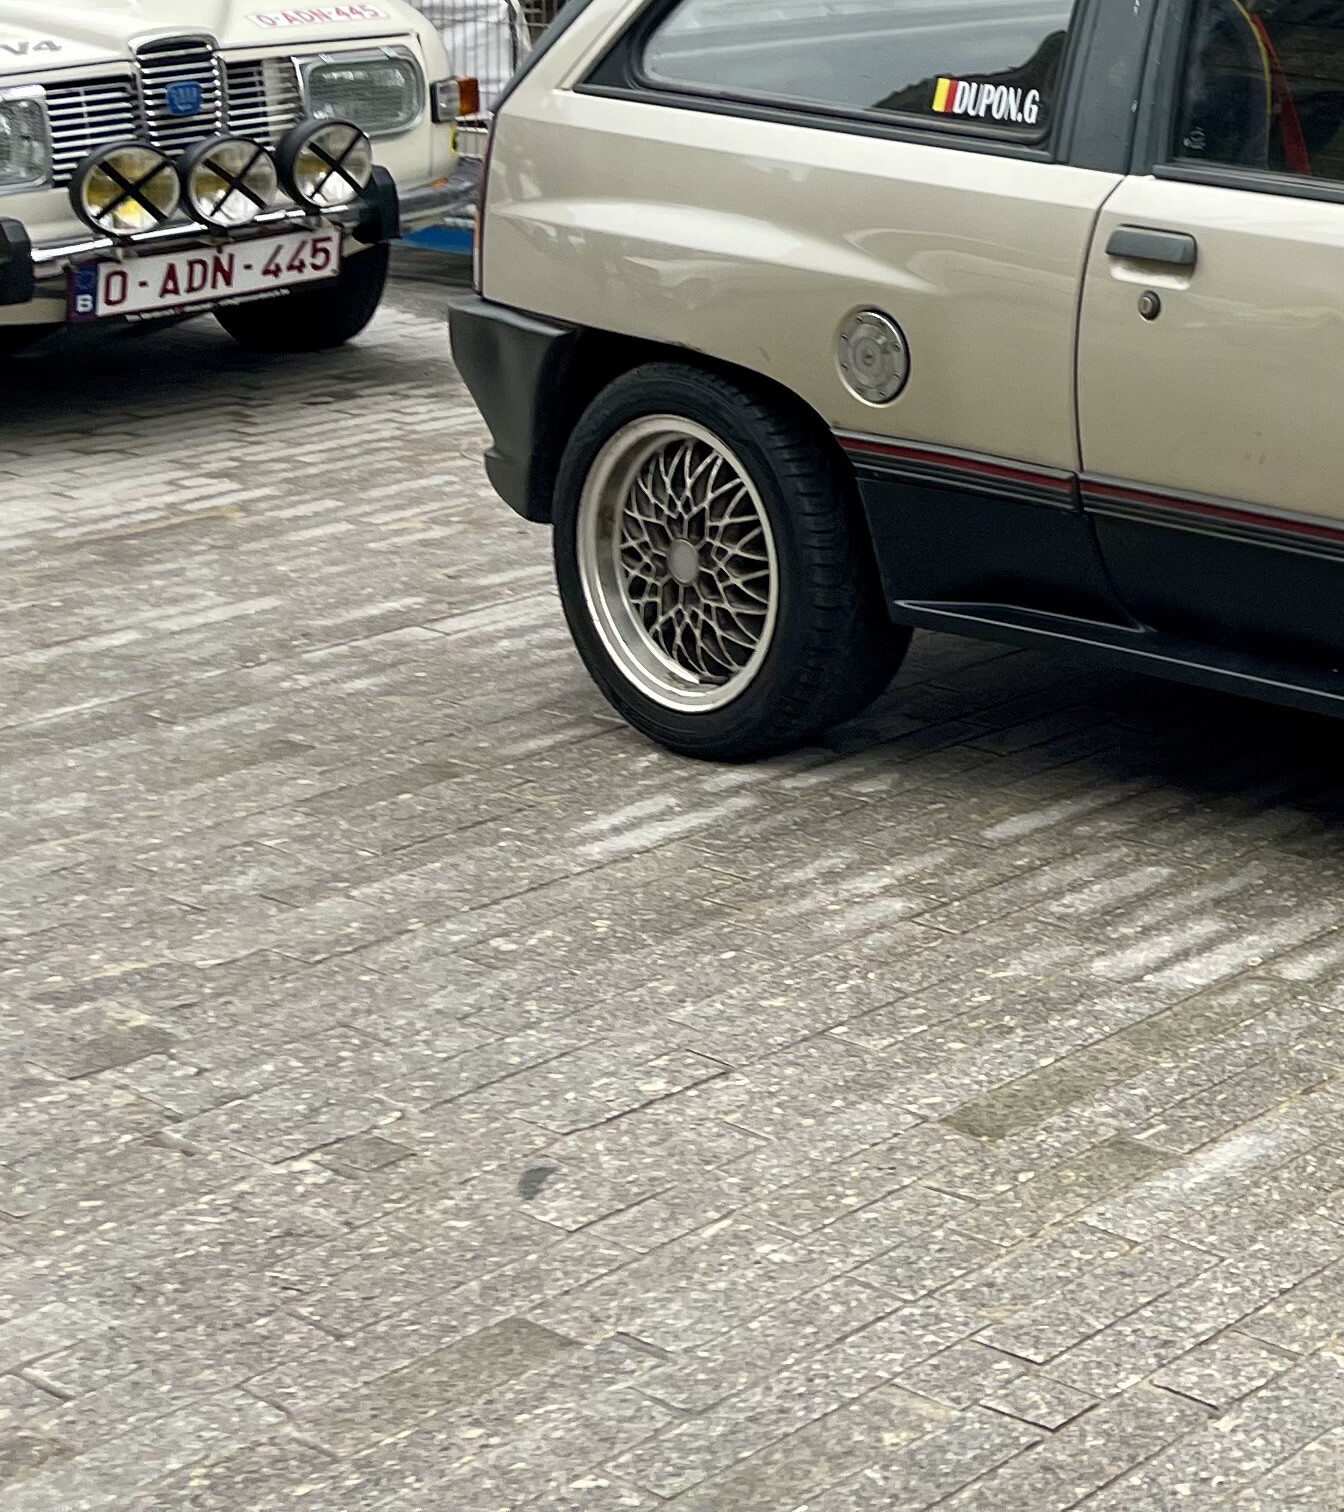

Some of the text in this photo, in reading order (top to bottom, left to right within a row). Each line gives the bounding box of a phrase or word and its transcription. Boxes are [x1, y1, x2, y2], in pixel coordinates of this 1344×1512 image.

[0, 39, 63, 56] V4
[953, 80, 1040, 124] DUPON.G
[76, 294, 93, 313] B
